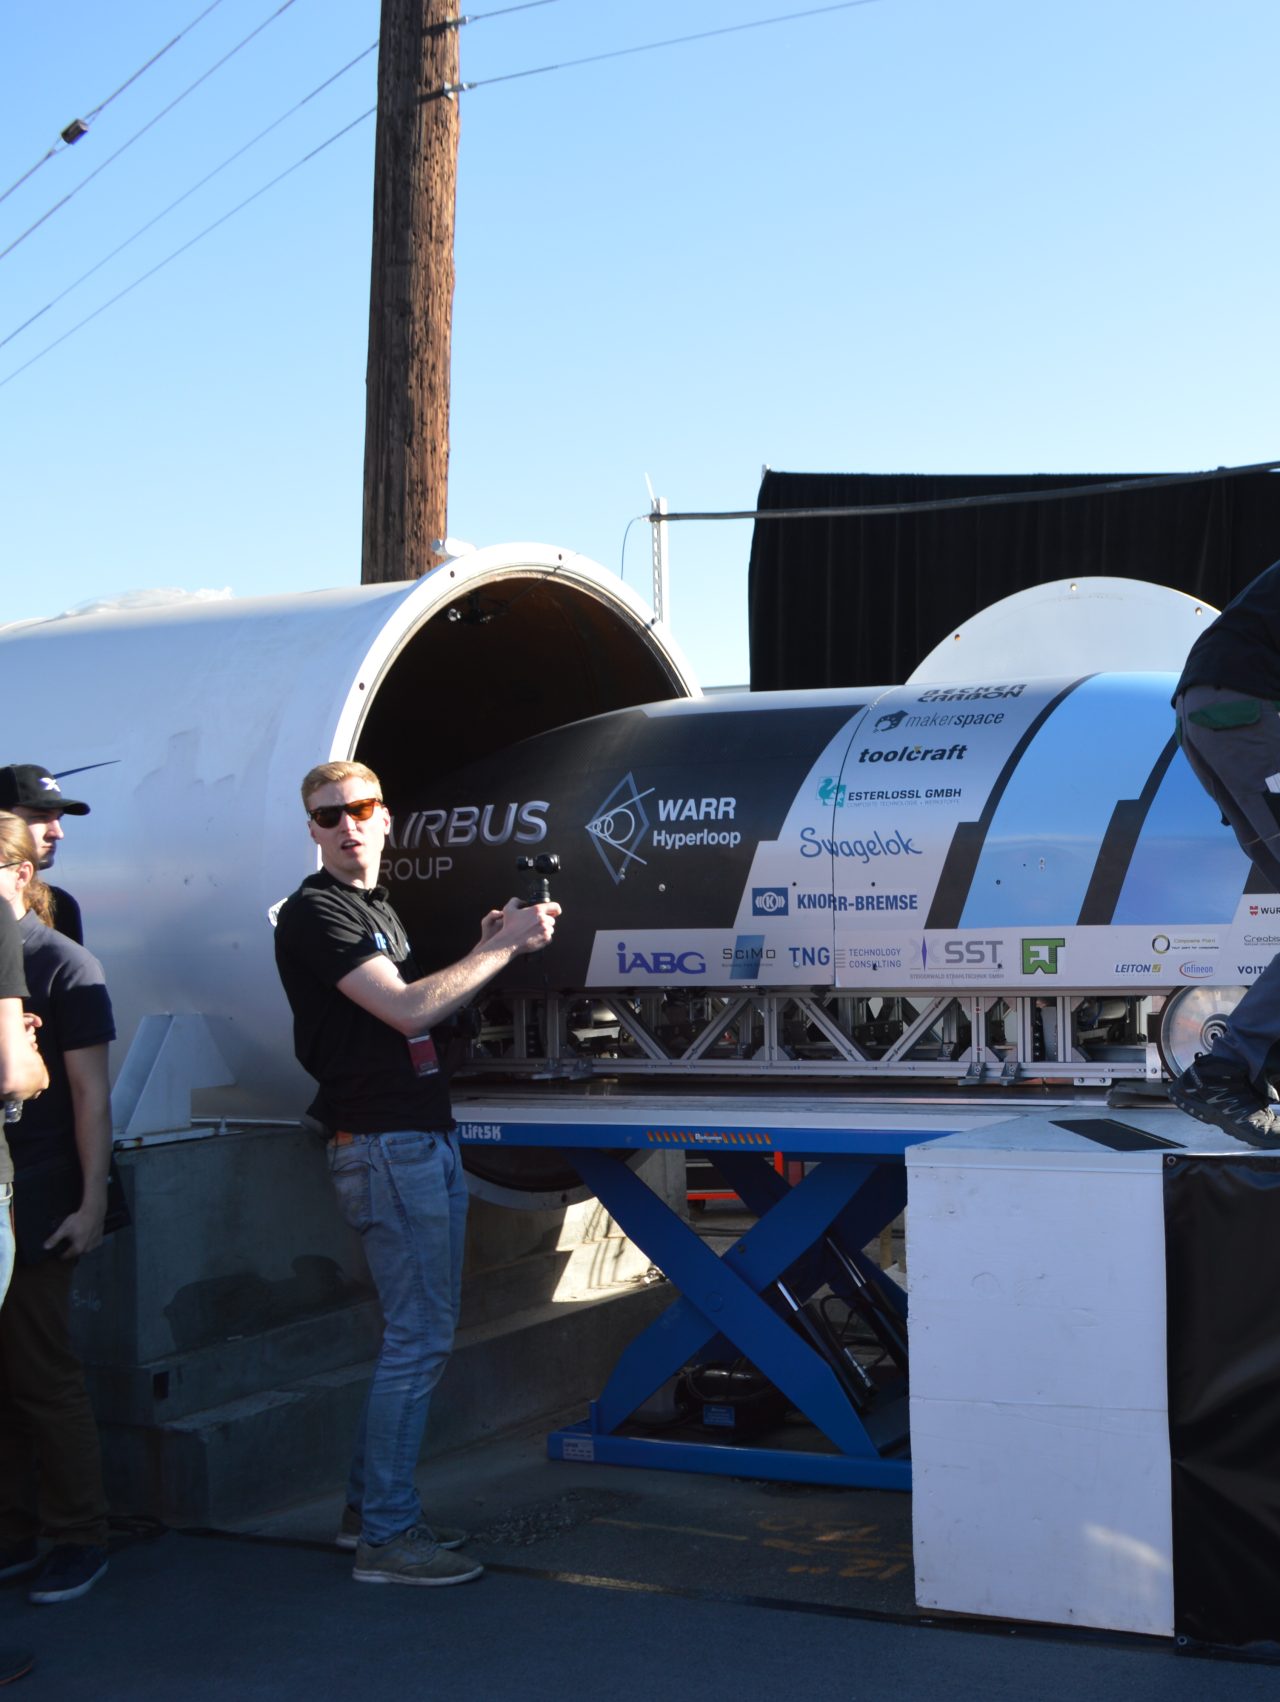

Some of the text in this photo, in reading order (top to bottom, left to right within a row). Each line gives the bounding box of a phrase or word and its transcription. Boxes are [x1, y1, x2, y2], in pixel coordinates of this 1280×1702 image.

[917, 690, 1024, 703] CARBON
[905, 711, 1005, 729] makerspace
[858, 744, 968, 764] toolcraft
[658, 797, 737, 822] WARR
[652, 829, 741, 850] Hyperloop
[800, 827, 923, 864] Swagelok
[378, 856, 453, 881] ROUP
[797, 893, 918, 911] KNORR-BREMSE
[616, 941, 706, 975] iABG
[788, 946, 831, 967] TNG
[849, 948, 901, 957] TECHNOLOGY
[944, 941, 1003, 964] SST
[849, 960, 902, 969] CONSULTING
[1115, 964, 1152, 973] LEITON
[1237, 965, 1268, 975] VOIT
